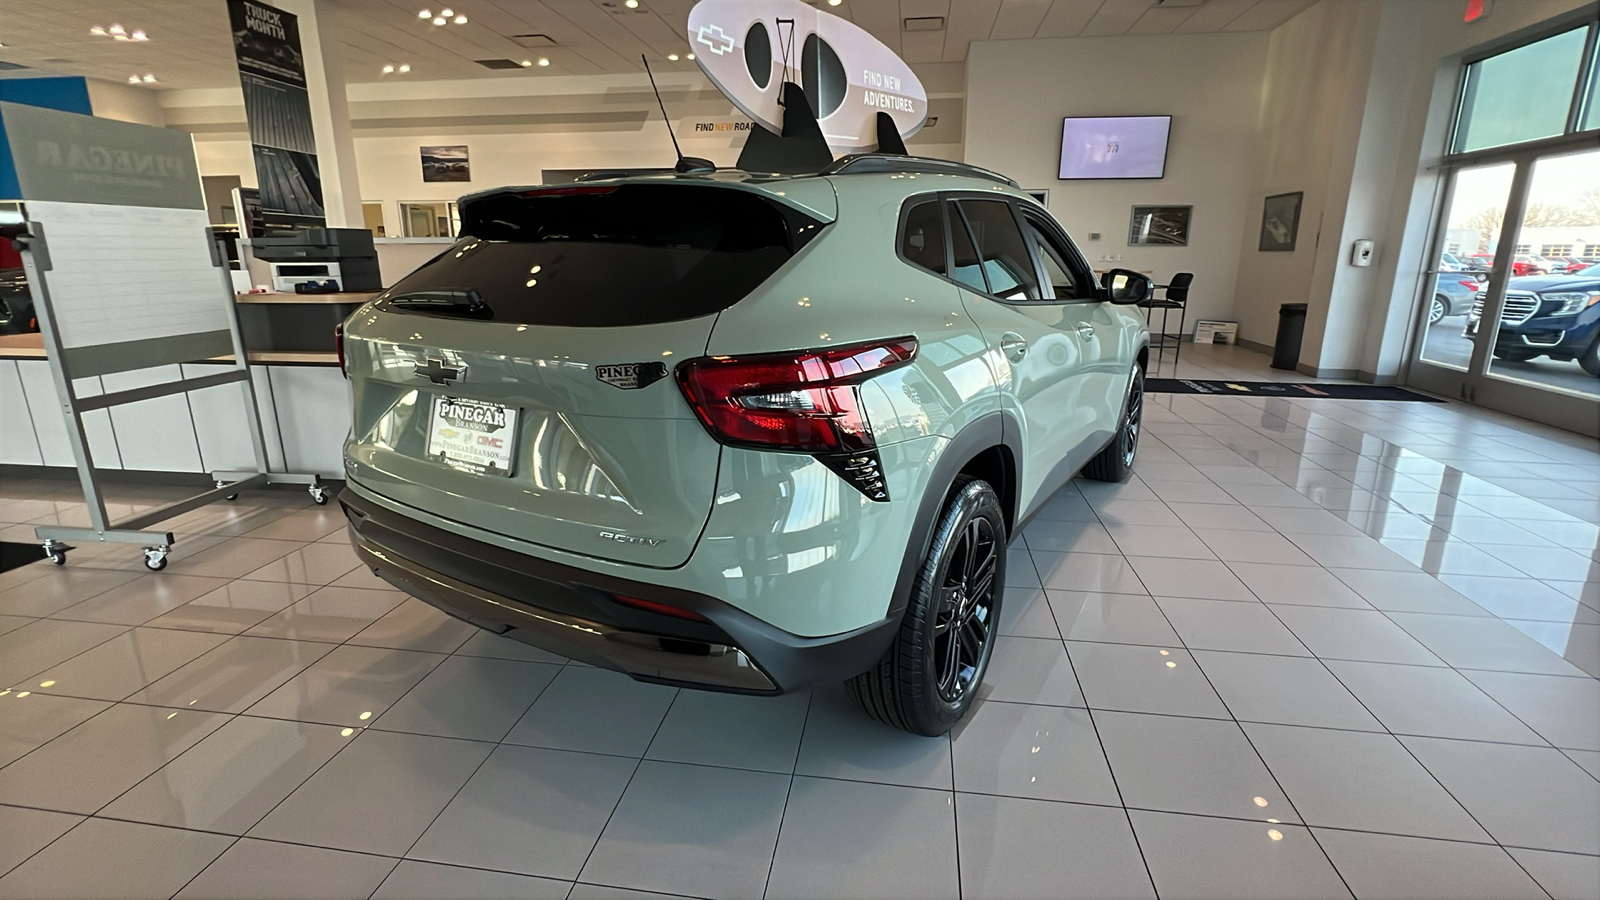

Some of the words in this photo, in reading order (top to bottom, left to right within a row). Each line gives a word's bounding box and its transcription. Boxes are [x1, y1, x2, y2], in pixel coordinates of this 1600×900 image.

[243, 1, 283, 28] TRUCK
[245, 15, 286, 41] MONTH
[863, 69, 882, 88] FIND
[884, 74, 901, 92] NEW
[863, 90, 915, 114] ADVENTURES.
[695, 123, 714, 132] FIND
[714, 122, 734, 132] NEW
[734, 122, 755, 131] ROA
[598, 364, 666, 378] PINEGR
[440, 402, 505, 427] PINEGAR
[455, 418, 489, 432] BRANSON
[477, 435, 504, 449] GMC
[599, 531, 666, 547] ACTIV
